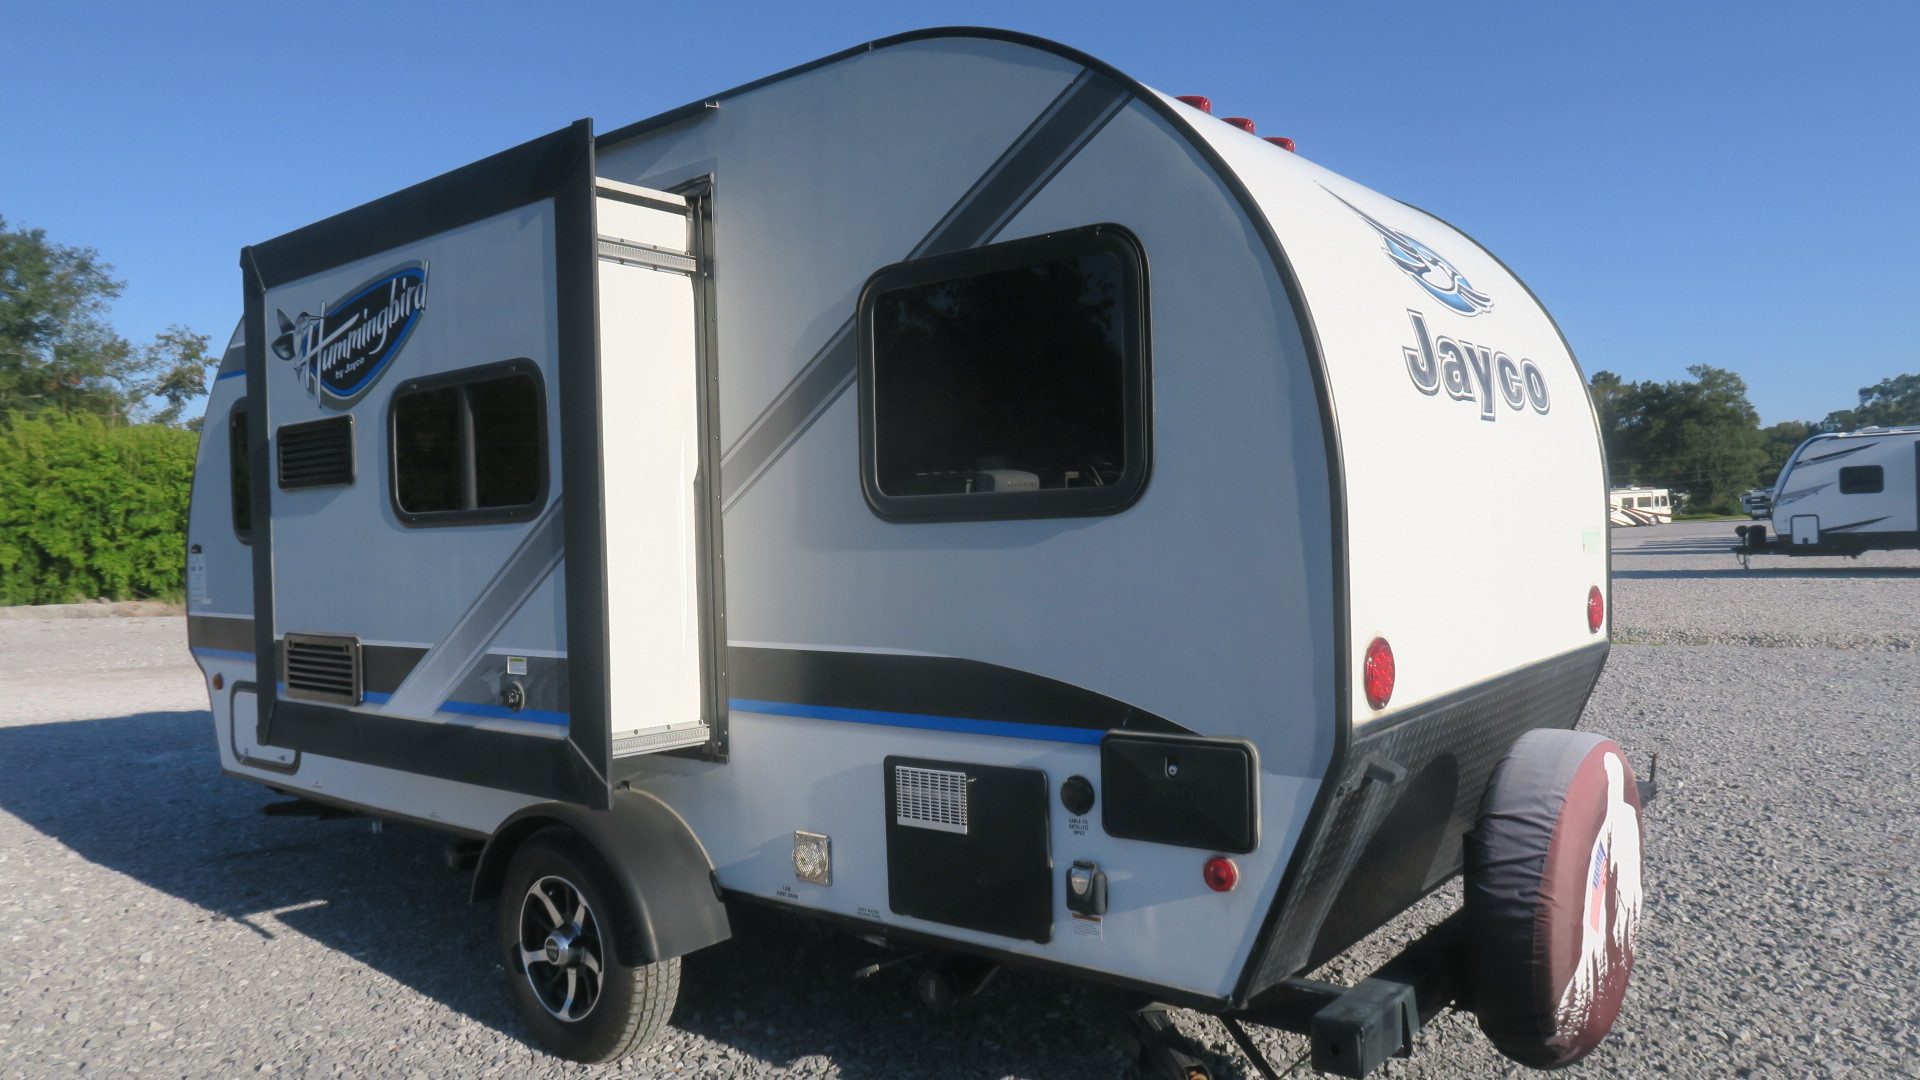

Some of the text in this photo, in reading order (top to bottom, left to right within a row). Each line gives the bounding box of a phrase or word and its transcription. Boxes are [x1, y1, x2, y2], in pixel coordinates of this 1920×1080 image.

[294, 259, 430, 408] Hummingbird
[335, 357, 365, 379] by Jayco
[1402, 308, 1550, 422] Jayco
